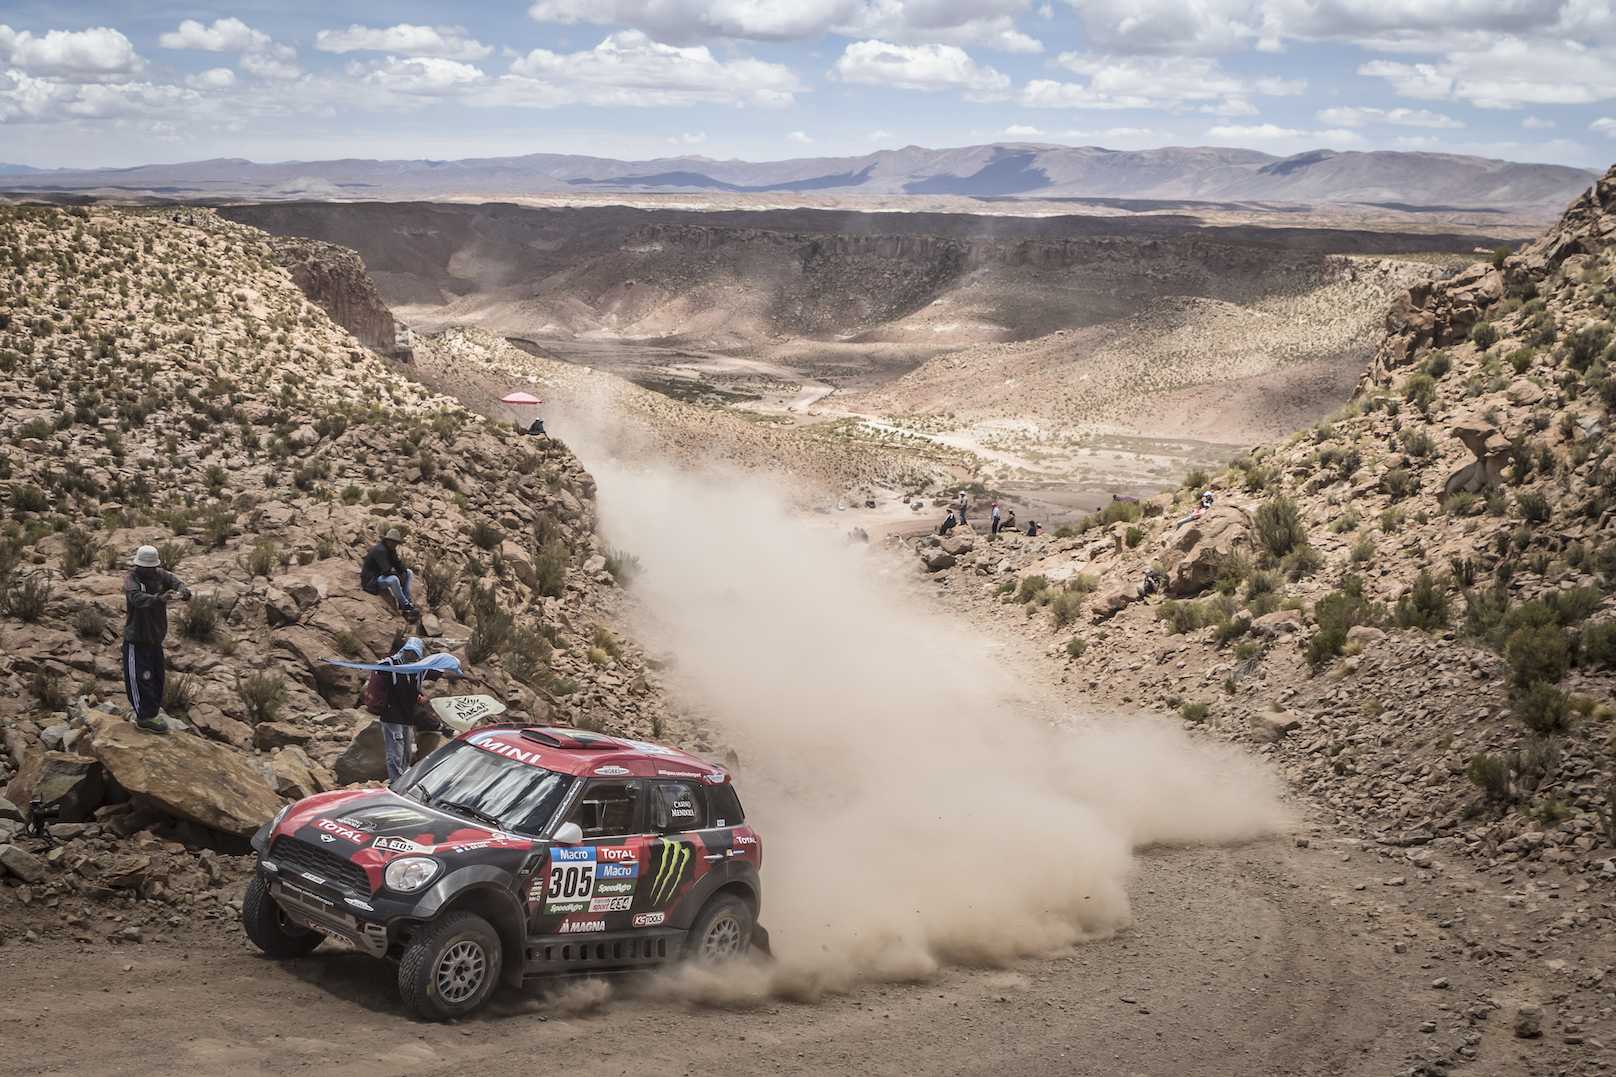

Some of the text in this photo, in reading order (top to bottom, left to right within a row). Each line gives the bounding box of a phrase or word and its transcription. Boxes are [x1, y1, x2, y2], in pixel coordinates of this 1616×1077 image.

[456, 702, 488, 719] DAKAR
[479, 738, 541, 764] MINI
[319, 819, 361, 842] TOTAL
[736, 836, 757, 844] TOTAL
[391, 841, 414, 851] 305
[560, 850, 588, 859] Macro
[601, 848, 635, 859] TOTAL
[603, 865, 632, 876] Macro
[548, 866, 593, 898] 305
[570, 920, 606, 932] MAGNA
